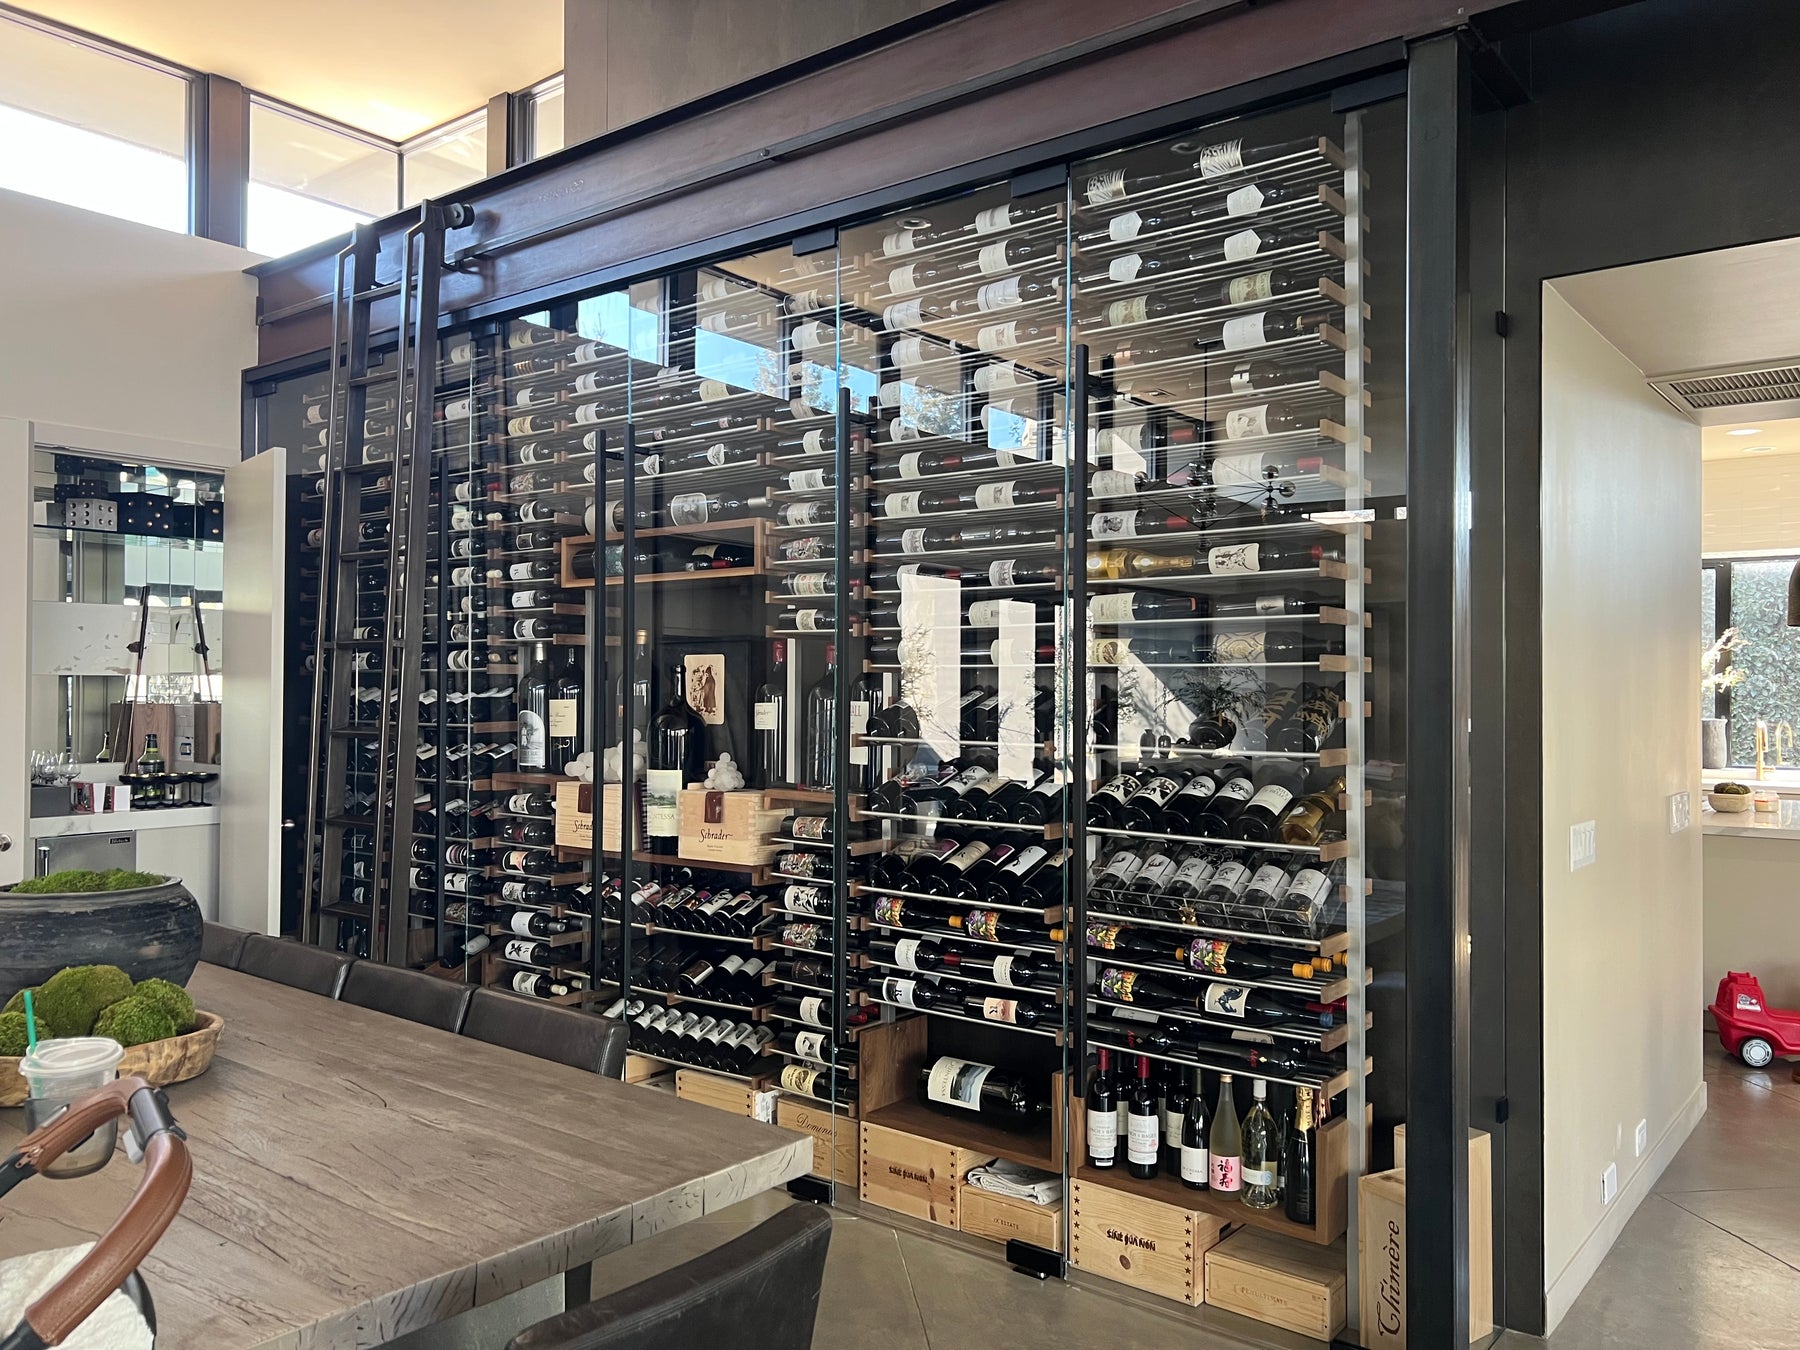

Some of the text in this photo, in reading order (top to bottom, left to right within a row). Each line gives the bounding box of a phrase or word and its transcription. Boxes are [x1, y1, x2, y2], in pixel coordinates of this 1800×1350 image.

[699, 828, 733, 843] Schrader
[1106, 1228, 1156, 1251] SINE QUA NON
[1376, 1220, 1401, 1337] Chimère
